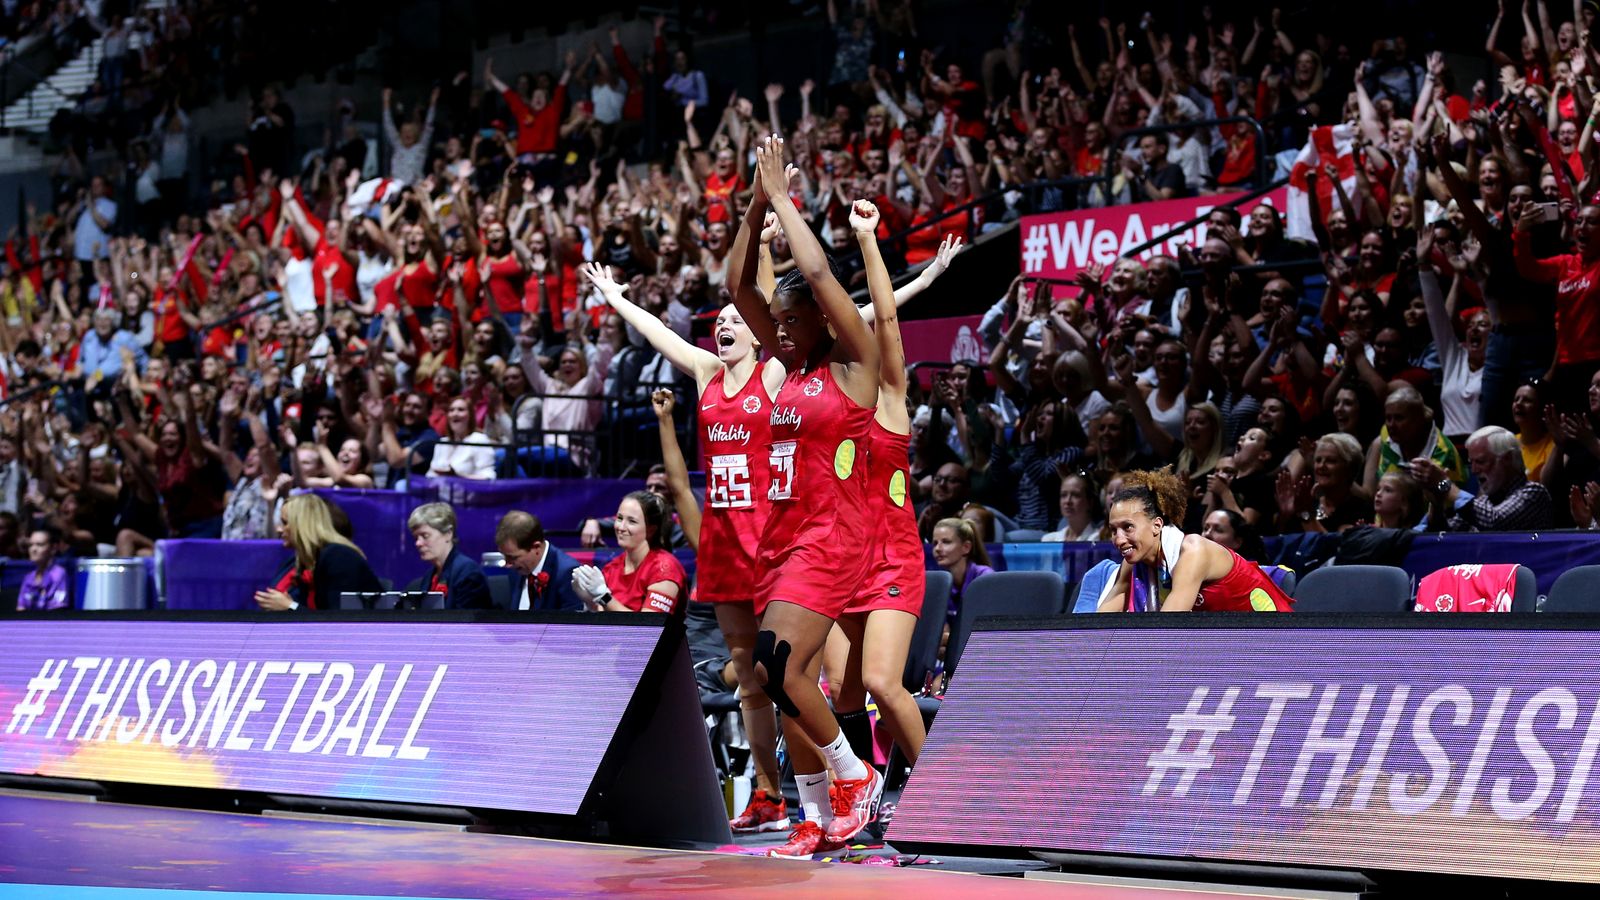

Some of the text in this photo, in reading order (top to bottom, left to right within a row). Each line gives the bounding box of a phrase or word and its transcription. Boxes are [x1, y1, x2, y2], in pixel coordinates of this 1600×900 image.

[707, 421, 751, 446] Vitality
[710, 466, 752, 508] GS
[6, 656, 448, 760] #THISISNETBALL
